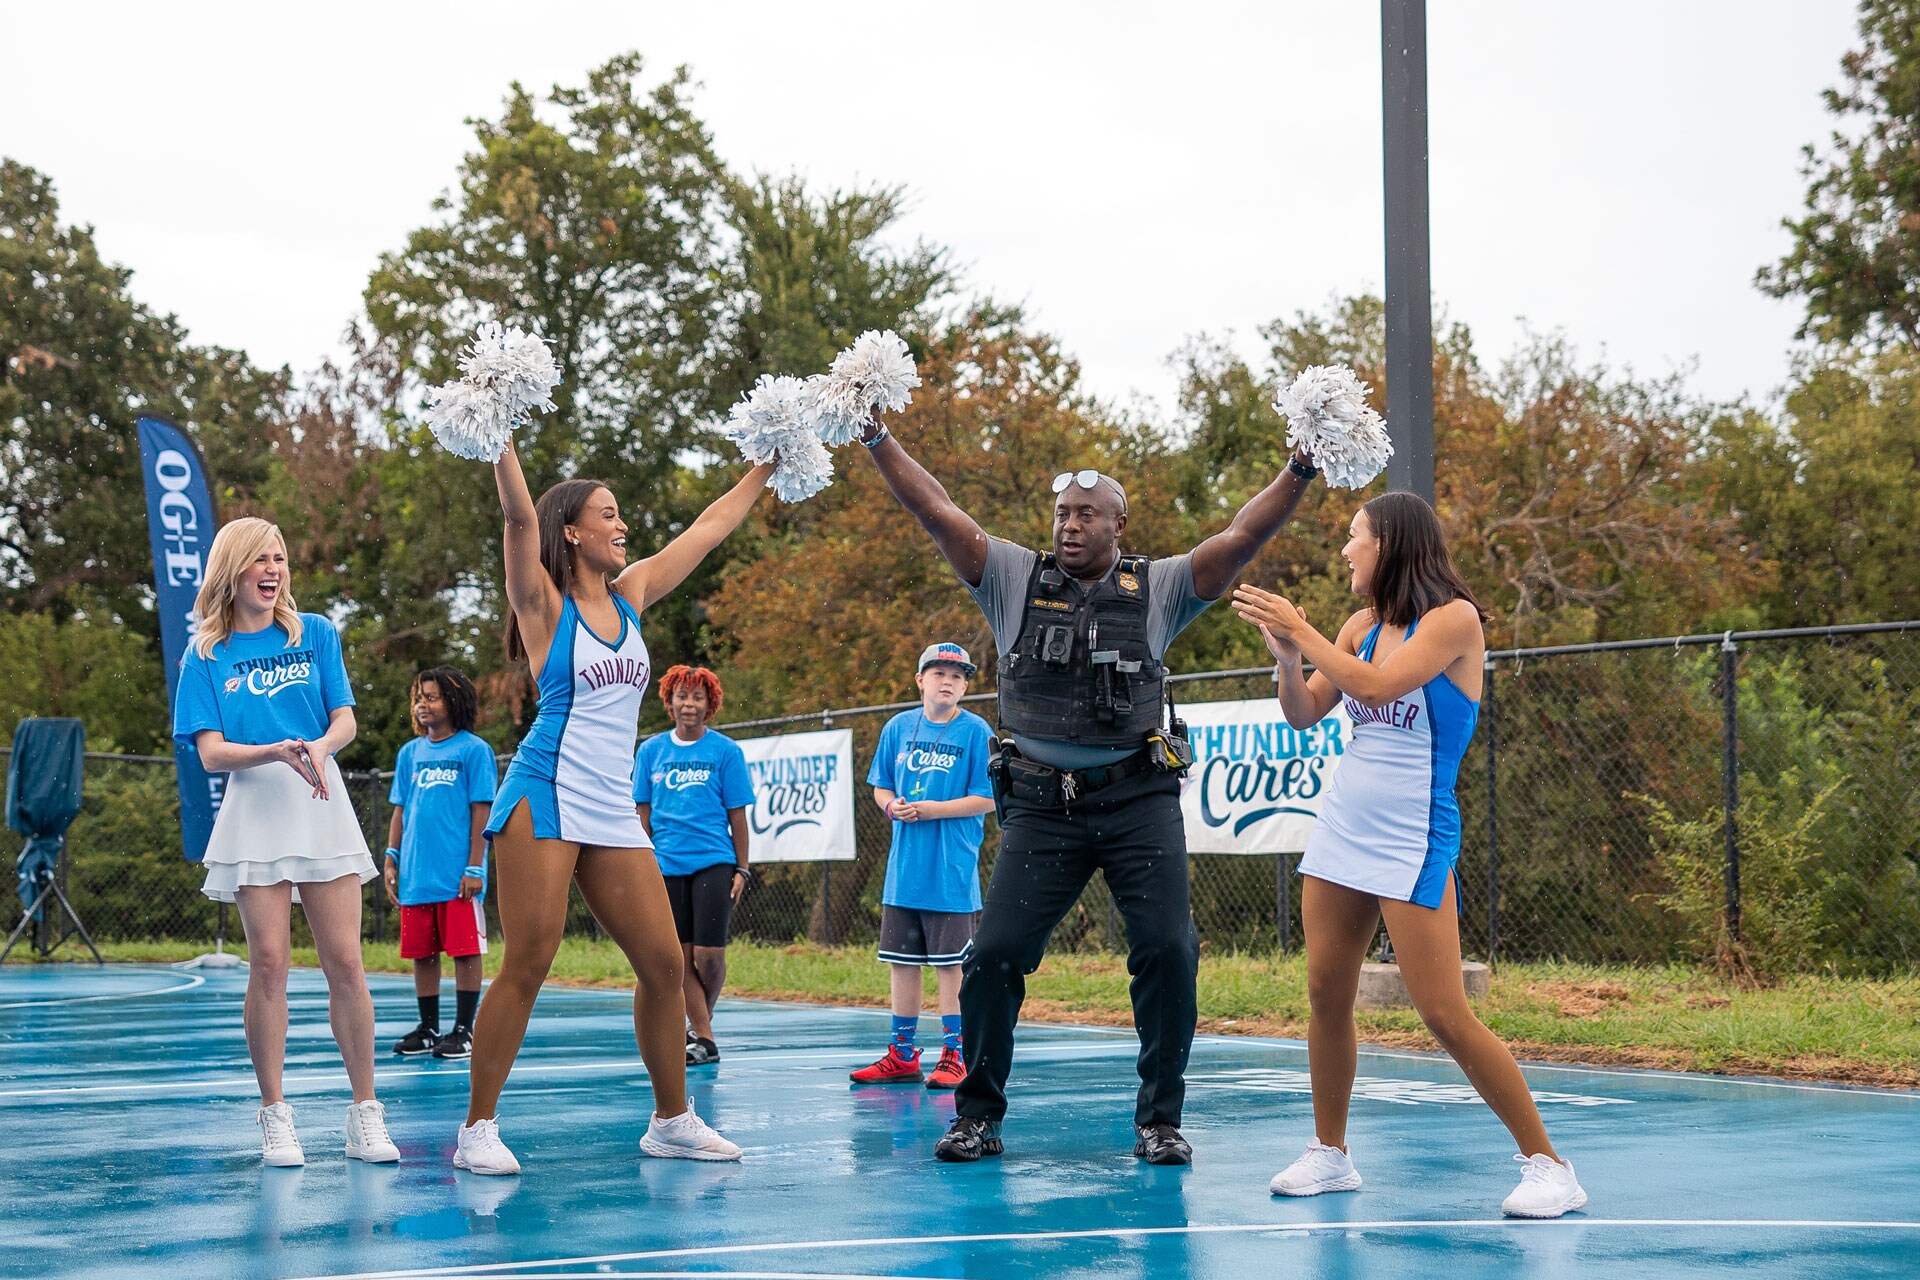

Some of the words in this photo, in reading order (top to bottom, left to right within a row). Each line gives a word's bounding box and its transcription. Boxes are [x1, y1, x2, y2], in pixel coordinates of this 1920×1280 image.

[232, 649, 315, 675] THUNDER
[578, 657, 650, 692] THUNDER
[247, 662, 311, 696] Cares
[905, 741, 965, 760] THUNDER
[1187, 717, 1344, 763] THUNDER
[662, 761, 716, 774] THUNDER
[906, 749, 957, 772] Cares
[417, 767, 459, 788] Cares
[665, 768, 711, 790] Cares
[1201, 753, 1325, 828] Cares
[751, 780, 829, 835] Cares
